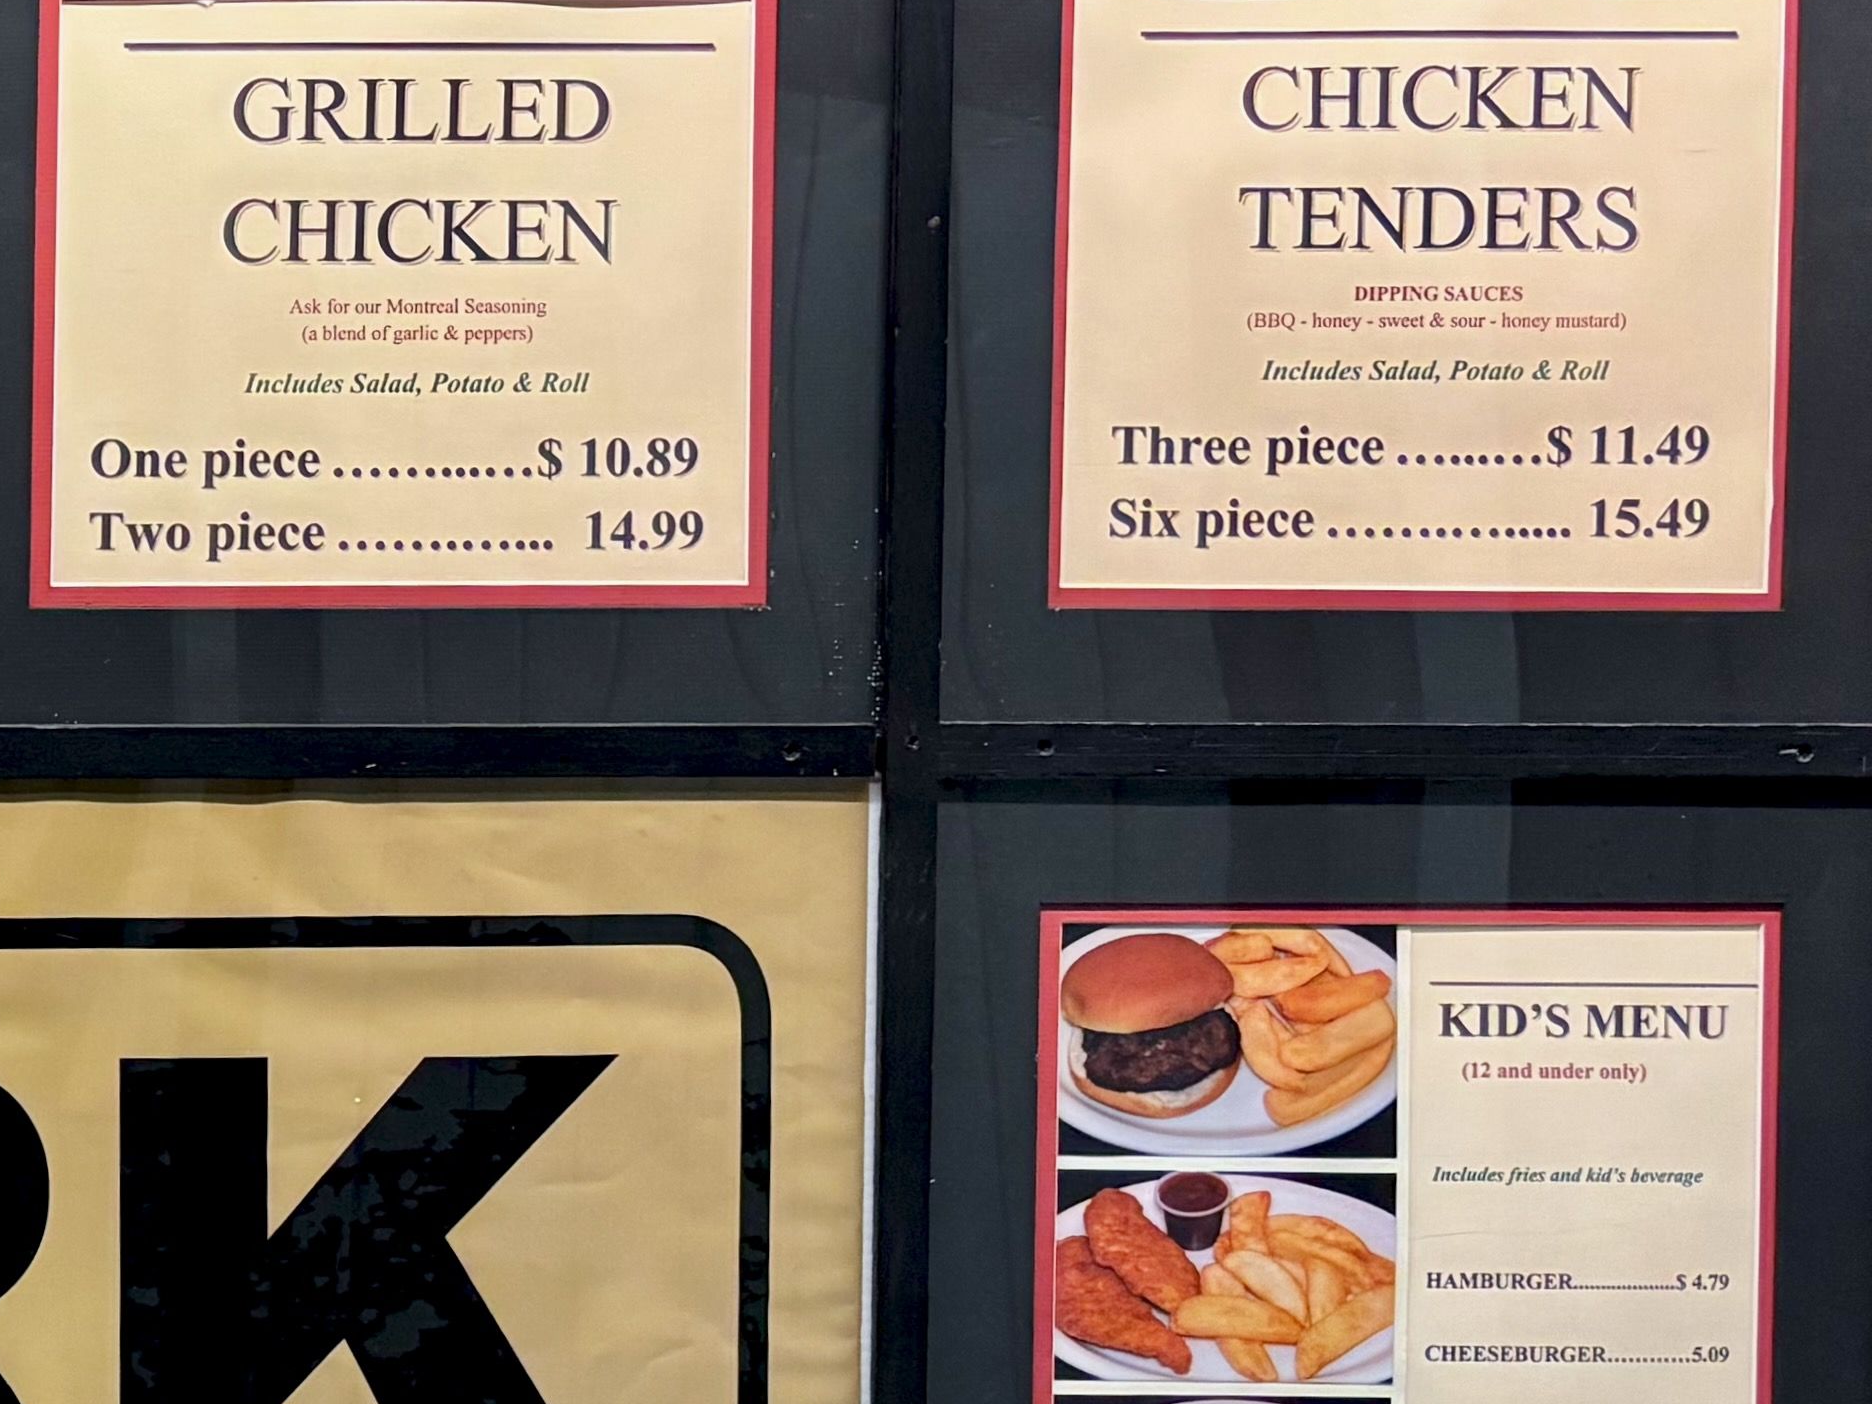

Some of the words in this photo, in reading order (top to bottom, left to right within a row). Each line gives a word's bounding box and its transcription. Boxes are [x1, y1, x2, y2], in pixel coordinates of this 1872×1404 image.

[233, 77, 610, 143] GRILLED
[1242, 64, 1642, 133] CHICKEN
[223, 198, 618, 266] CHICKEN
[1238, 186, 1638, 253] TENDERS
[289, 297, 322, 315] Ask
[327, 298, 351, 315] for
[354, 302, 382, 315] our
[386, 297, 459, 315] Montreal
[464, 298, 547, 318] Seasoning
[1354, 285, 1439, 302] DIPPING
[1443, 285, 1524, 302] SAUCES
[322, 324, 366, 341] blend
[371, 324, 392, 341] of
[392, 324, 439, 345] garlic
[464, 325, 534, 346] peppers)
[1246, 312, 1296, 332] (BBQ
[1312, 311, 1363, 332] honey
[1377, 314, 1425, 329] sweet
[1449, 316, 1487, 329] sour
[1501, 311, 1551, 333] honey
[1555, 312, 1627, 332] mustard)
[90, 438, 188, 479] One
[201, 438, 321, 490] piece
[580, 437, 699, 478] 10.89
[1111, 425, 1251, 466] Three
[1265, 424, 1385, 477] piece
[1591, 424, 1710, 465] 11.49
[89, 512, 191, 552] Two
[206, 511, 326, 563] piece
[585, 510, 704, 551] 14.99
[1109, 498, 1181, 539] Six
[1195, 497, 1315, 550] piece
[1590, 498, 1710, 539] 15.49
[1584, 1004, 1729, 1040] MENU
[1461, 1061, 1491, 1082] (12
[1497, 1062, 1533, 1079] and
[1538, 1062, 1595, 1080] under
[1599, 1062, 1647, 1085] only)
[1432, 1166, 1505, 1183] Includes
[1505, 1166, 1547, 1187] fries
[1549, 1167, 1583, 1183] and
[1629, 1167, 1704, 1188] beverage
[1691, 1273, 1730, 1291] 4.79
